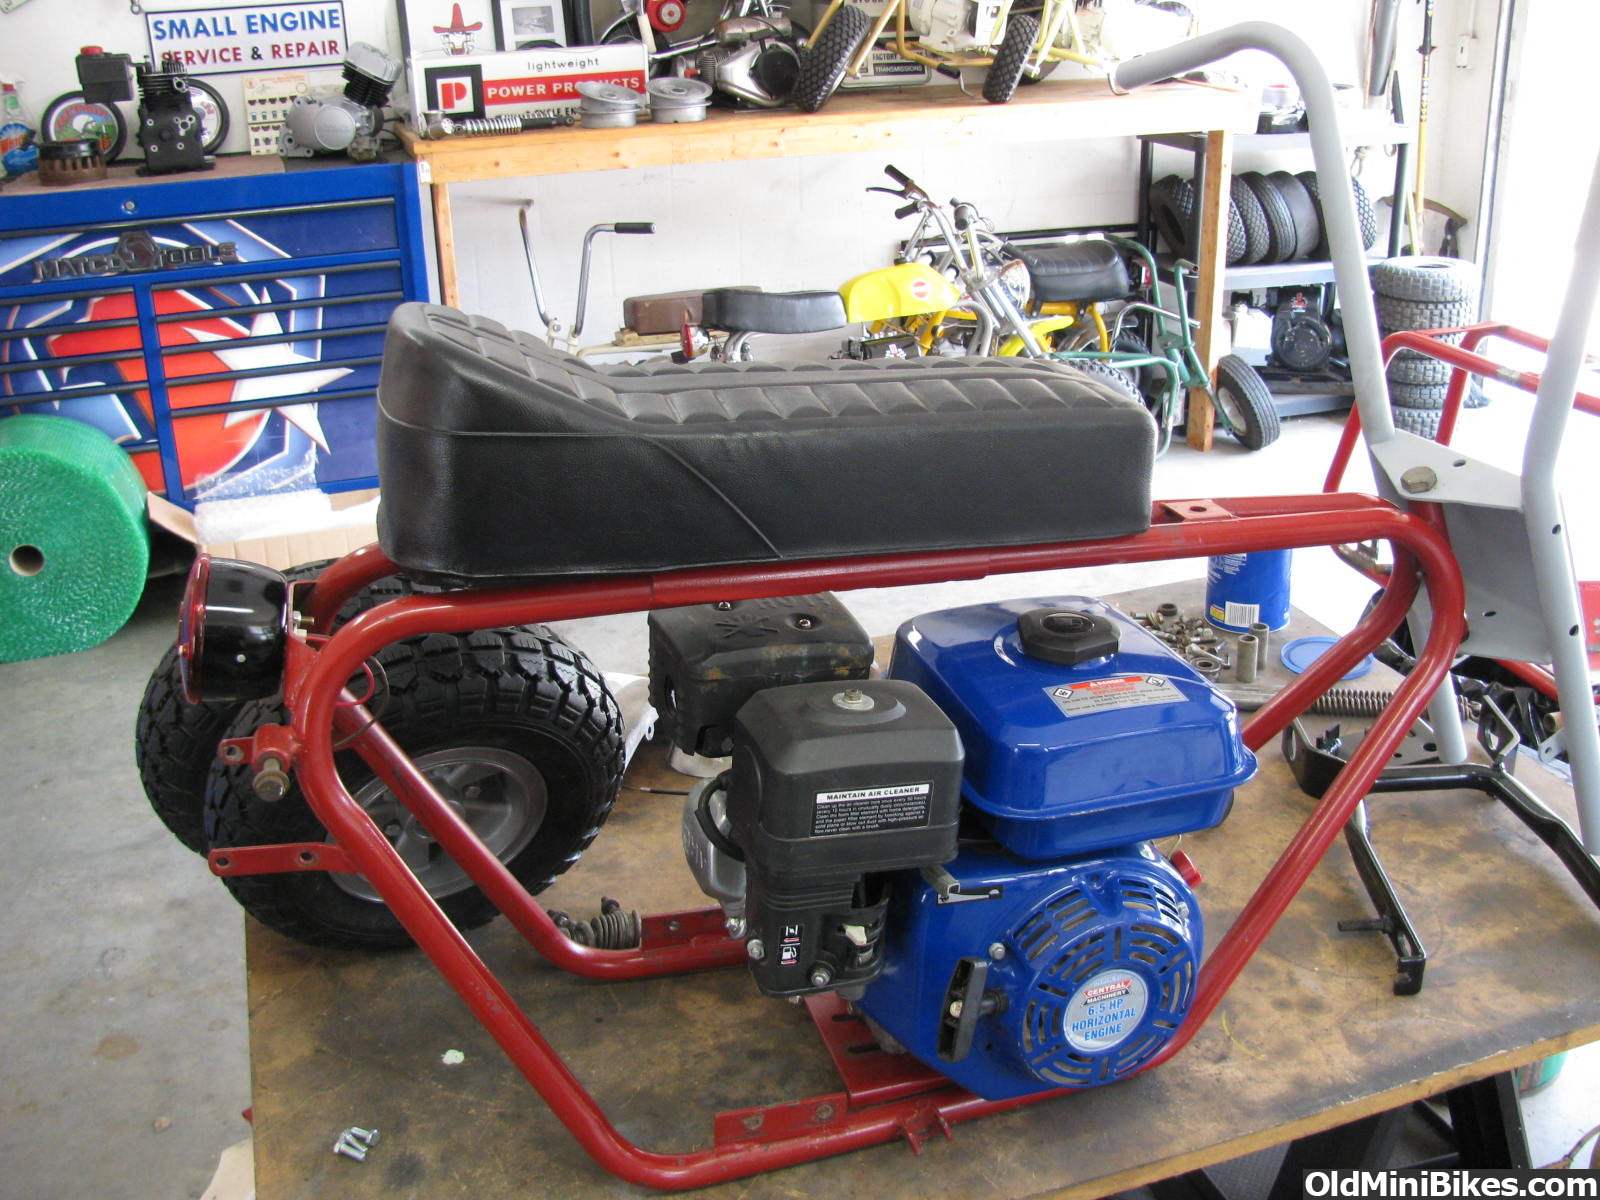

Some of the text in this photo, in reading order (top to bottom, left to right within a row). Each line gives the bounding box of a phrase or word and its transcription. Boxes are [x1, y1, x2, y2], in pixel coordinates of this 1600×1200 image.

[153, 8, 341, 40] SMALL ENGINE
[161, 39, 340, 66] SERVICE & REPAIR
[527, 57, 600, 73] lightweight
[487, 77, 640, 100] POWER PRCTS
[32, 241, 237, 281] MATCO TOOLS
[826, 786, 920, 801] MAINTAIN AIR CLEANER
[1087, 982, 1126, 996] CENTRAL
[1087, 990, 1127, 1003] MACHINERY
[1088, 999, 1124, 1016] 6.5 HP
[1072, 1008, 1136, 1032] HORIZONTAL
[1084, 1023, 1123, 1040] ENGINE
